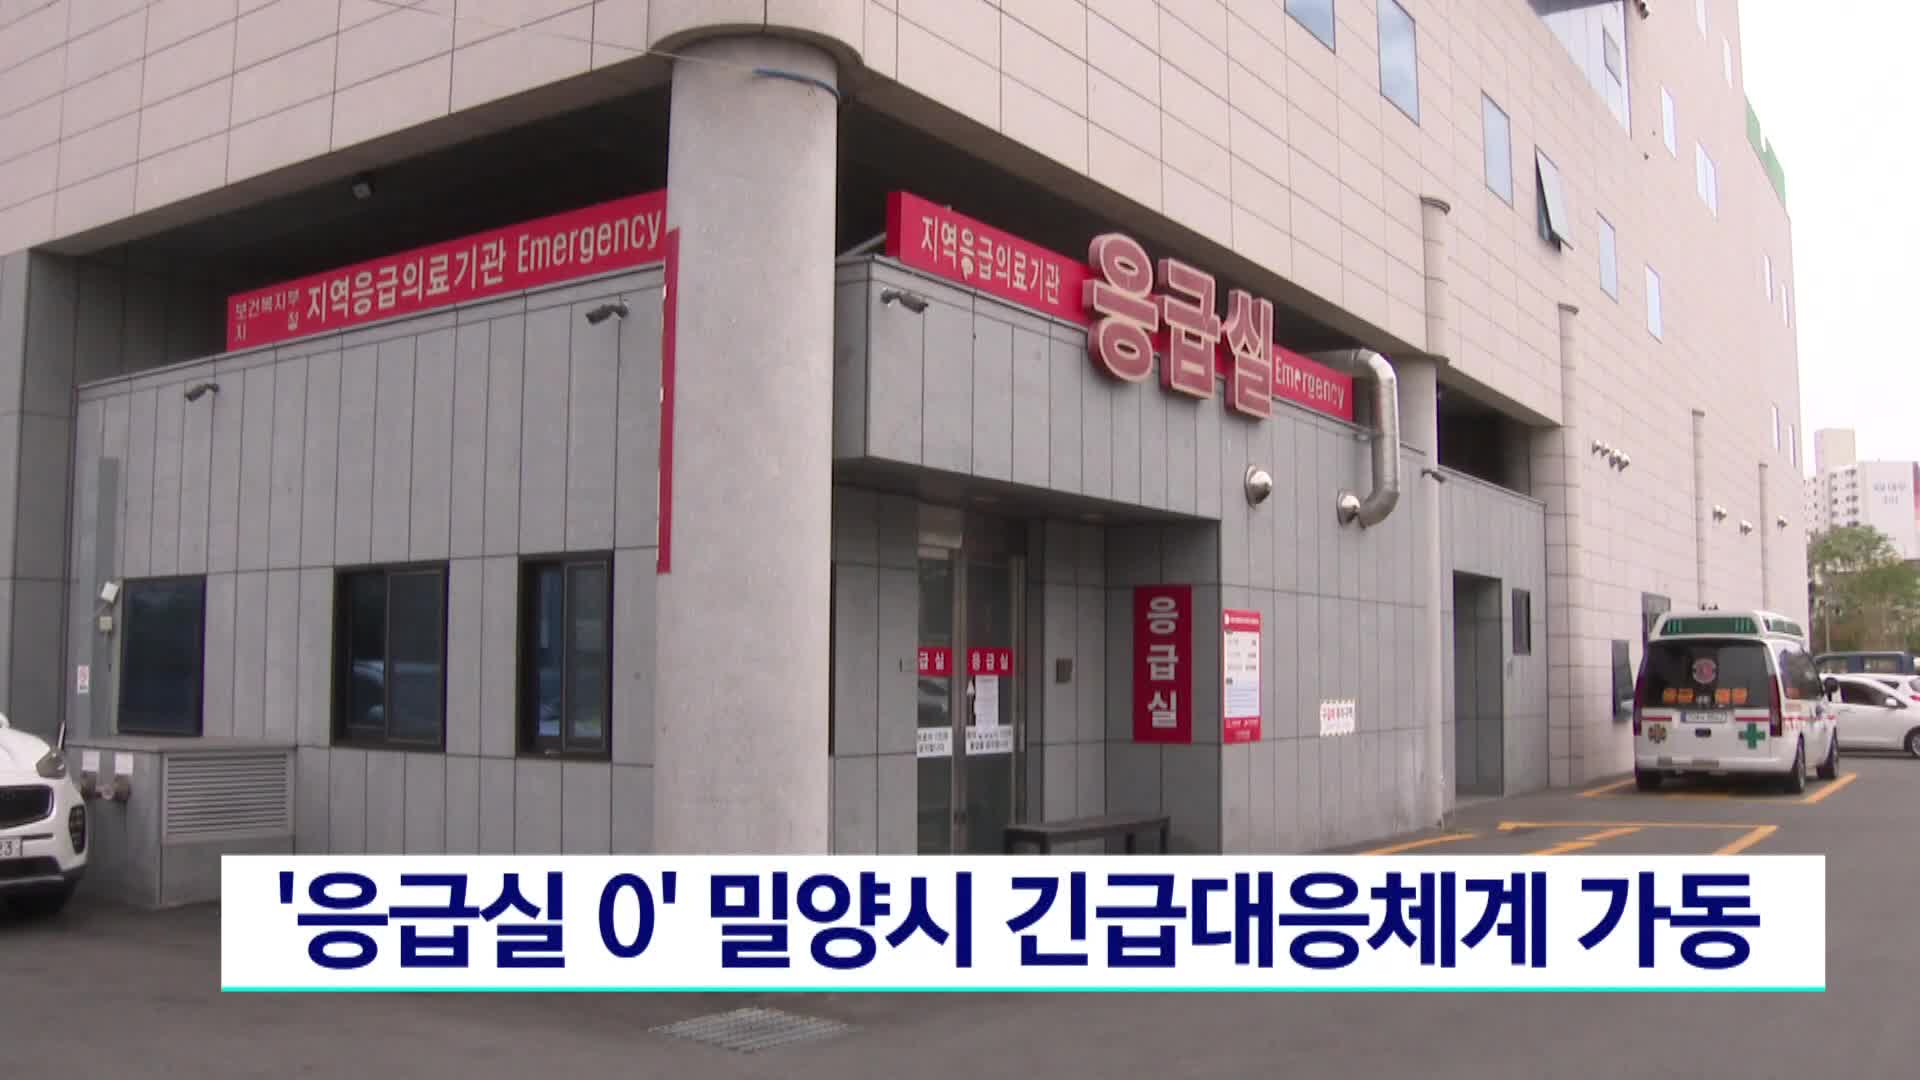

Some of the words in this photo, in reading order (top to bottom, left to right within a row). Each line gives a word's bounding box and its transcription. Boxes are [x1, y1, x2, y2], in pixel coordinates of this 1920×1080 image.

[306, 237, 507, 323] 지역응급의료기관
[517, 210, 662, 274] Emergency
[921, 216, 1060, 305] 지역응급의료기관
[235, 288, 299, 320] 보건복지부
[1083, 232, 1274, 418] 응급실
[1275, 356, 1345, 409] Emergency
[1146, 596, 1180, 729] 응급실
